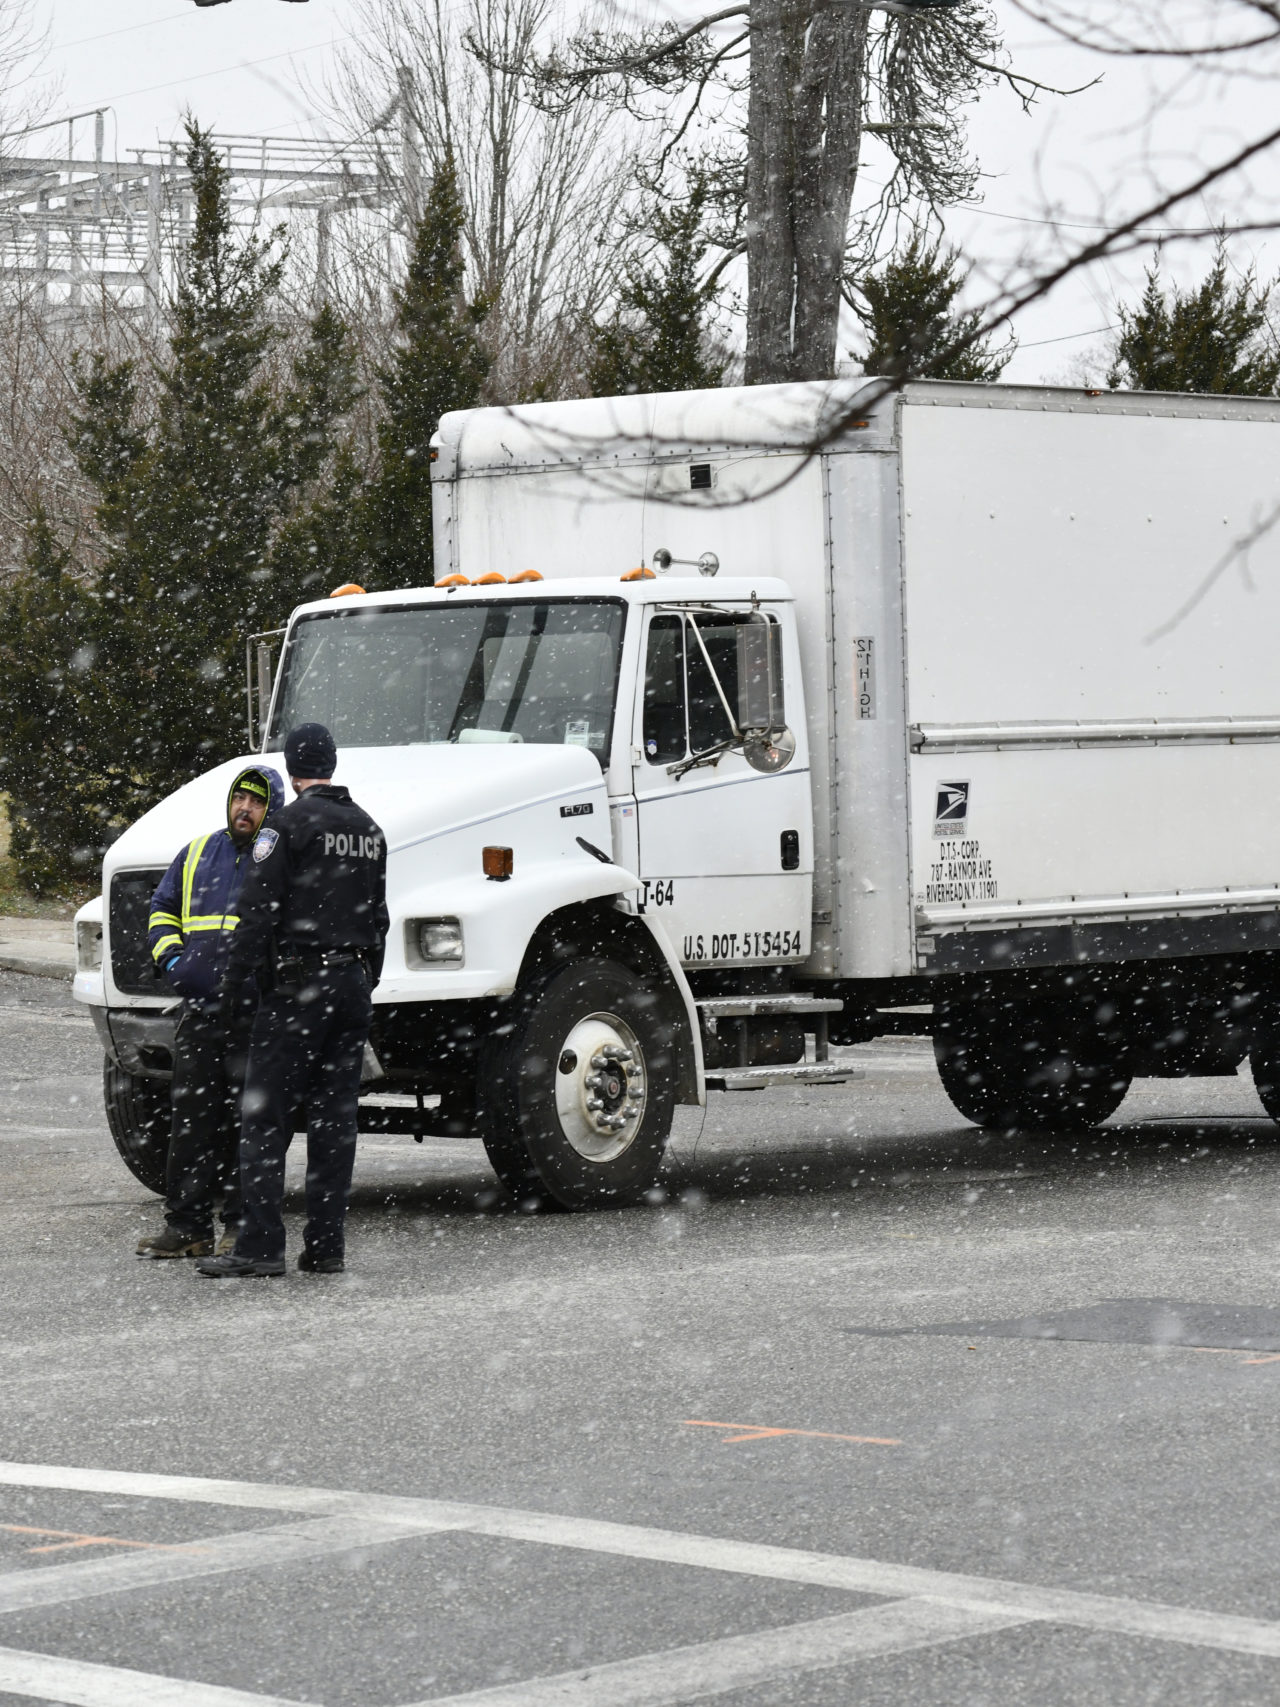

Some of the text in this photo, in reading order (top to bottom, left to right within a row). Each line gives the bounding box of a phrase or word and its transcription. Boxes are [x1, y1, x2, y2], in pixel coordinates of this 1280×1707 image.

[564, 804, 591, 816] FL70
[324, 832, 381, 861] POLICE
[926, 882, 963, 903] RIVERHEAD
[979, 880, 998, 899] 11901
[684, 934, 707, 960] U.S.
